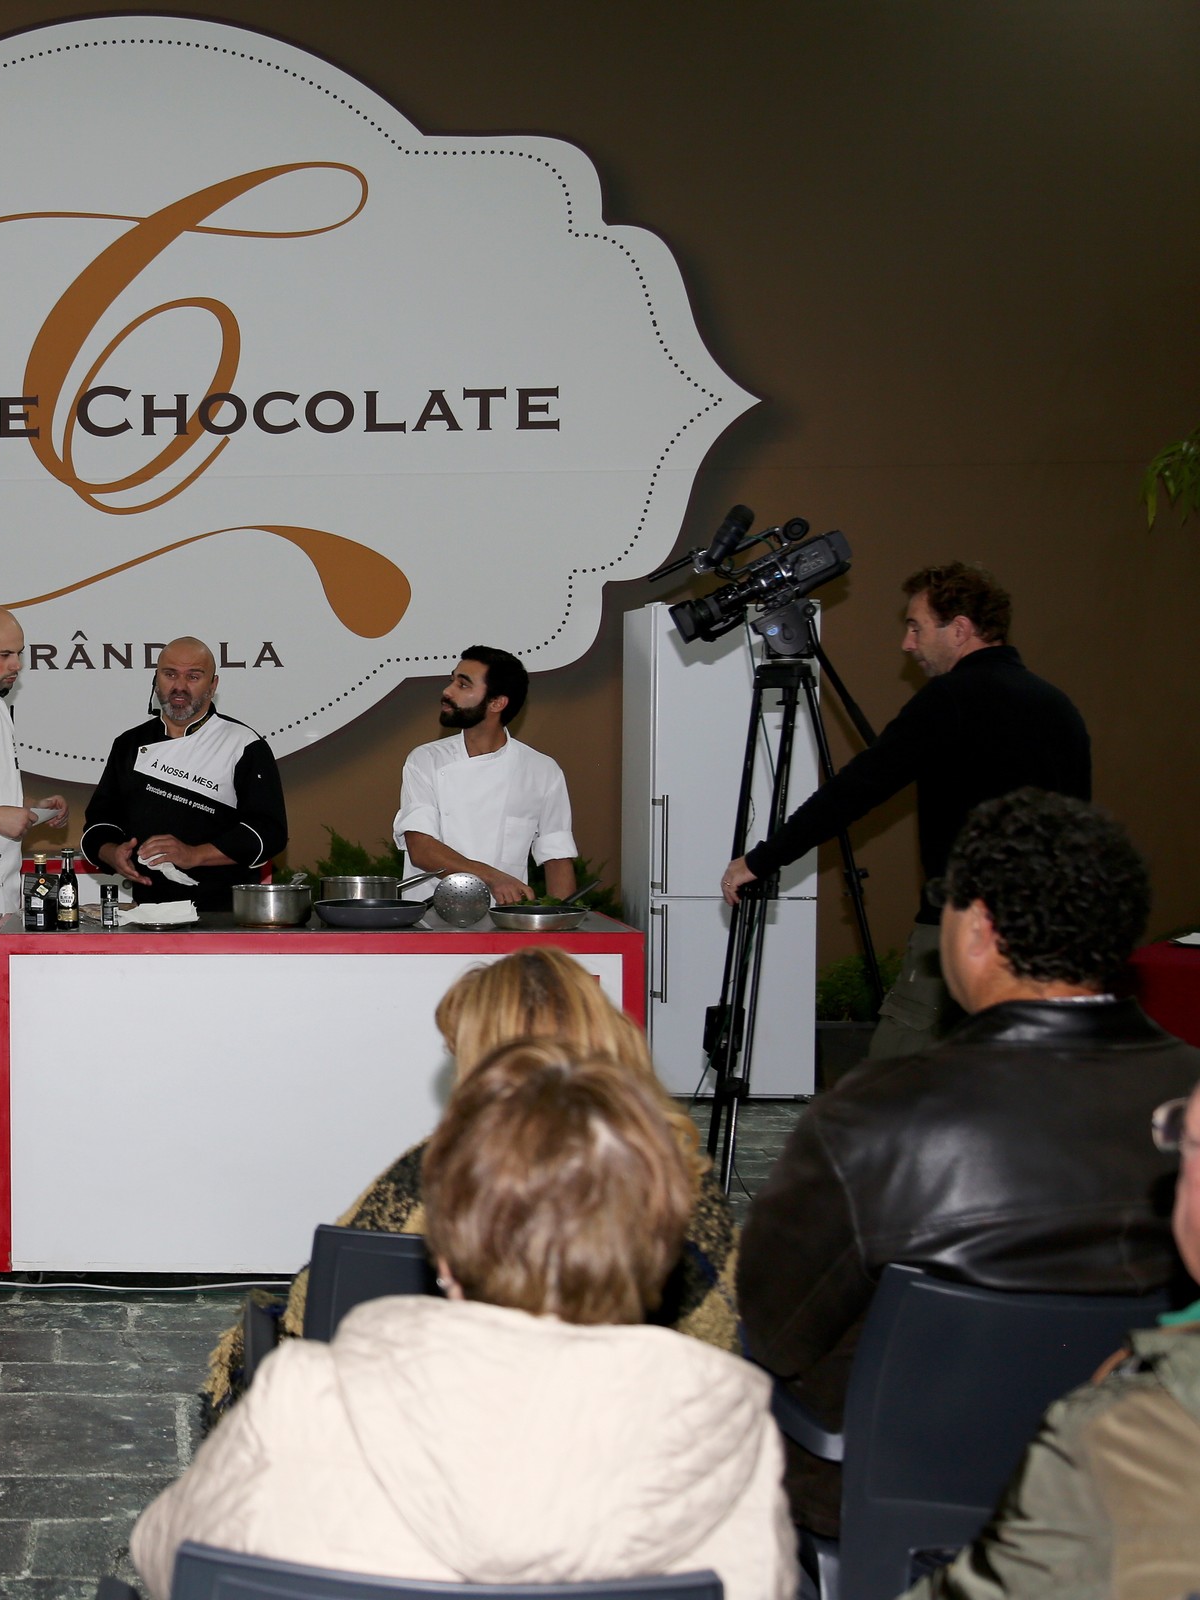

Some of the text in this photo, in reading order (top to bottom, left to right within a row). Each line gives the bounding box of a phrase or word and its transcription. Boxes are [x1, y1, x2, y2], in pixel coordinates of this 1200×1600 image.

[76, 384, 560, 438] CHOCOLATE
[160, 764, 190, 780] NOSSA
[192, 774, 220, 792] MESA
[145, 783, 167, 797] Descoberta
[166, 791, 173, 799] de
[172, 795, 189, 804] sabores
[192, 802, 216, 814] produtores
